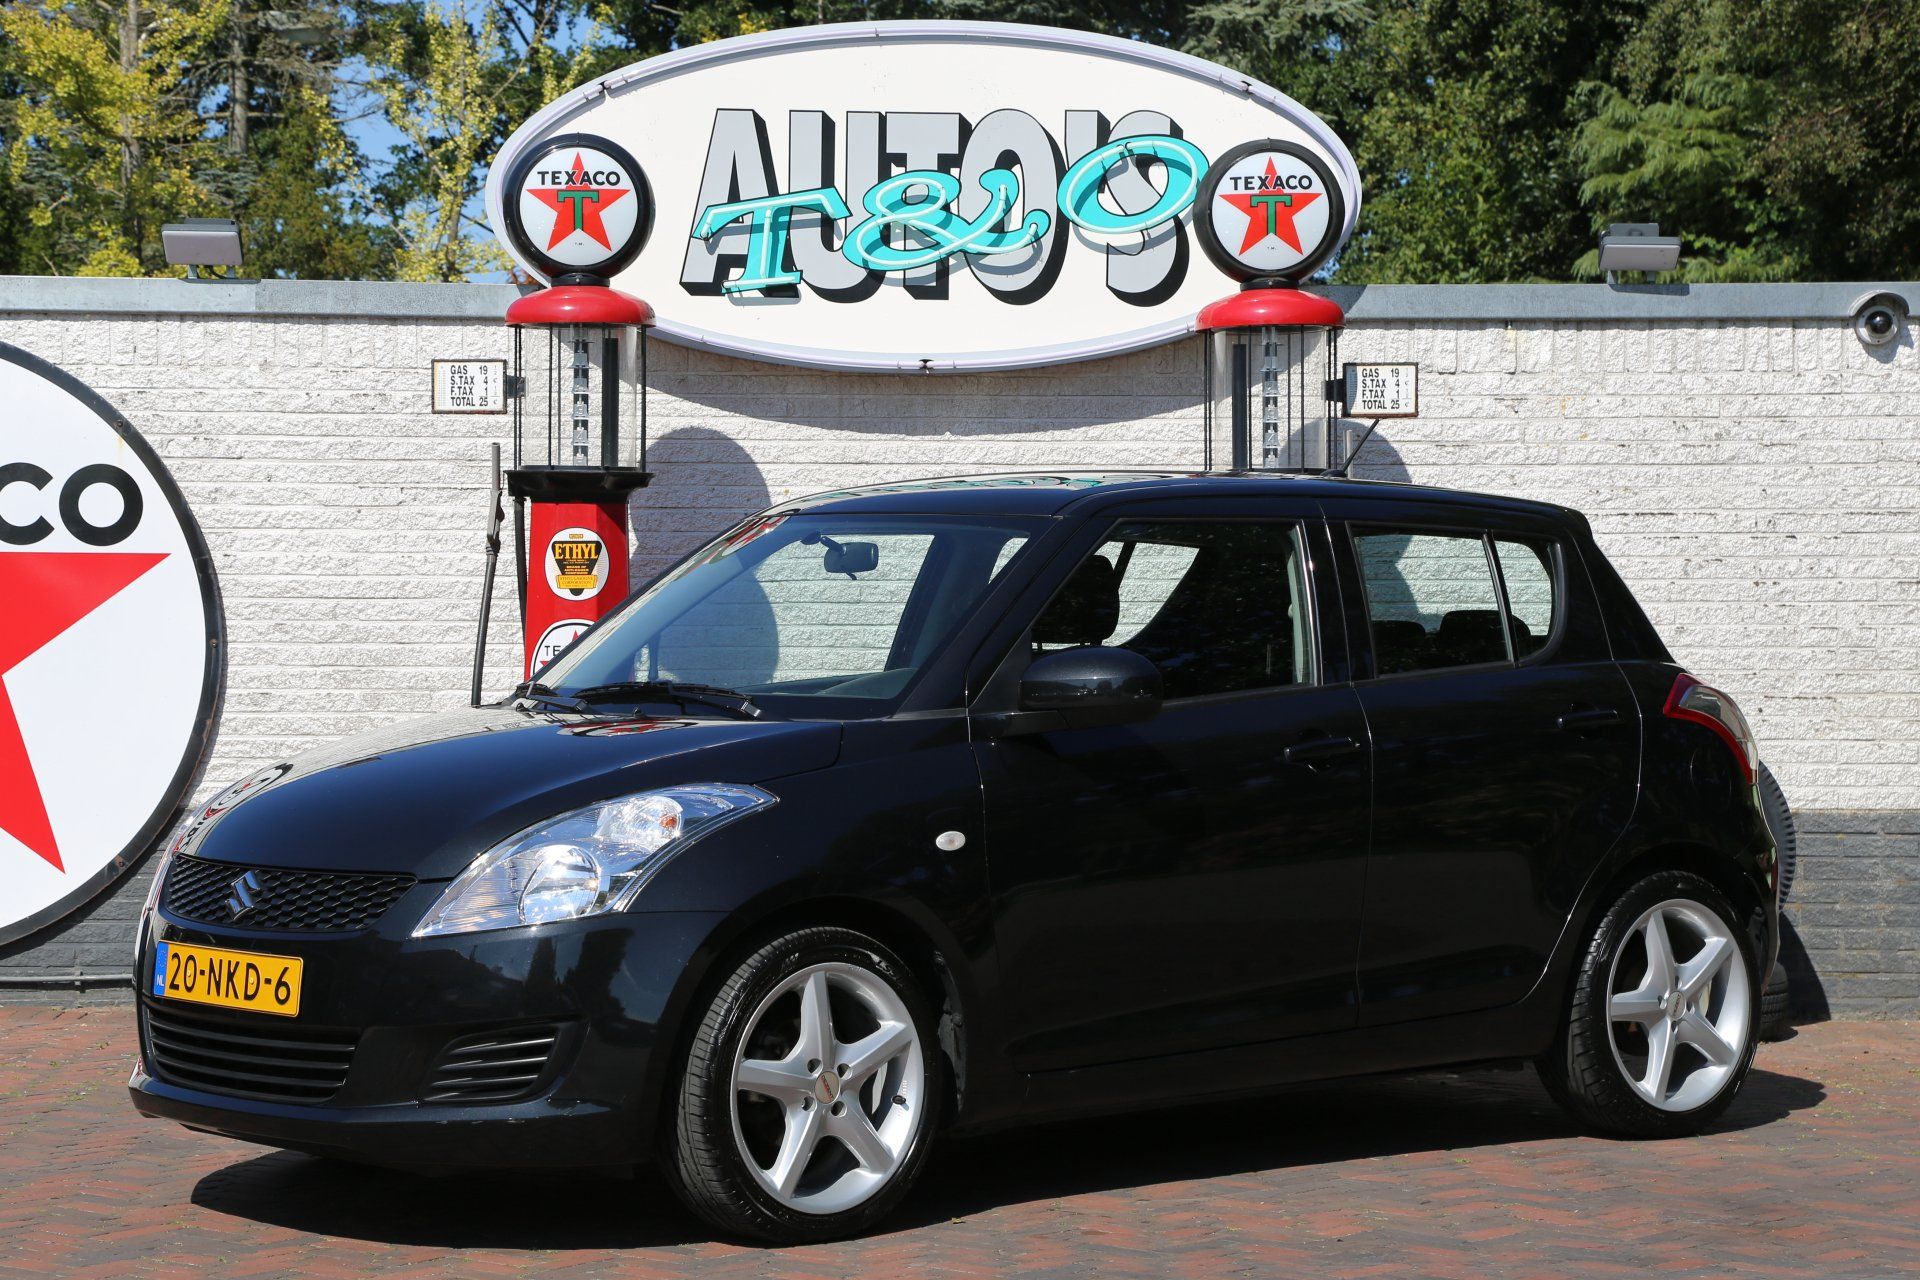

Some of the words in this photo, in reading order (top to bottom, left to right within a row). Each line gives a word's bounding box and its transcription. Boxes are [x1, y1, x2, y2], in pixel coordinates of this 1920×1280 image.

[537, 170, 621, 186] TEXACO
[1229, 174, 1313, 191] TEXACO
[679, 108, 1190, 307] AUTO'S
[450, 364, 468, 375] GAS
[479, 365, 488, 375] 19
[1361, 368, 1379, 378] GAS
[1390, 368, 1400, 378] 19
[450, 375, 475, 386] S.TAX
[483, 376, 488, 386] 4
[1361, 378, 1387, 389] S.TAX
[1394, 379, 1400, 389] 4
[450, 386, 474, 396] F.TAX
[484, 387, 488, 396] 1
[1361, 389, 1385, 399] F.TAX
[1396, 390, 1400, 399] 1
[450, 396, 476, 407] TOTAL
[479, 397, 489, 407] 25
[1361, 399, 1388, 410] TOTAL
[1390, 400, 1400, 410] 25
[554, 543, 599, 559] ETHYL
[156, 974, 165, 986] NL
[169, 952, 291, 1006] 20-NKD-6
